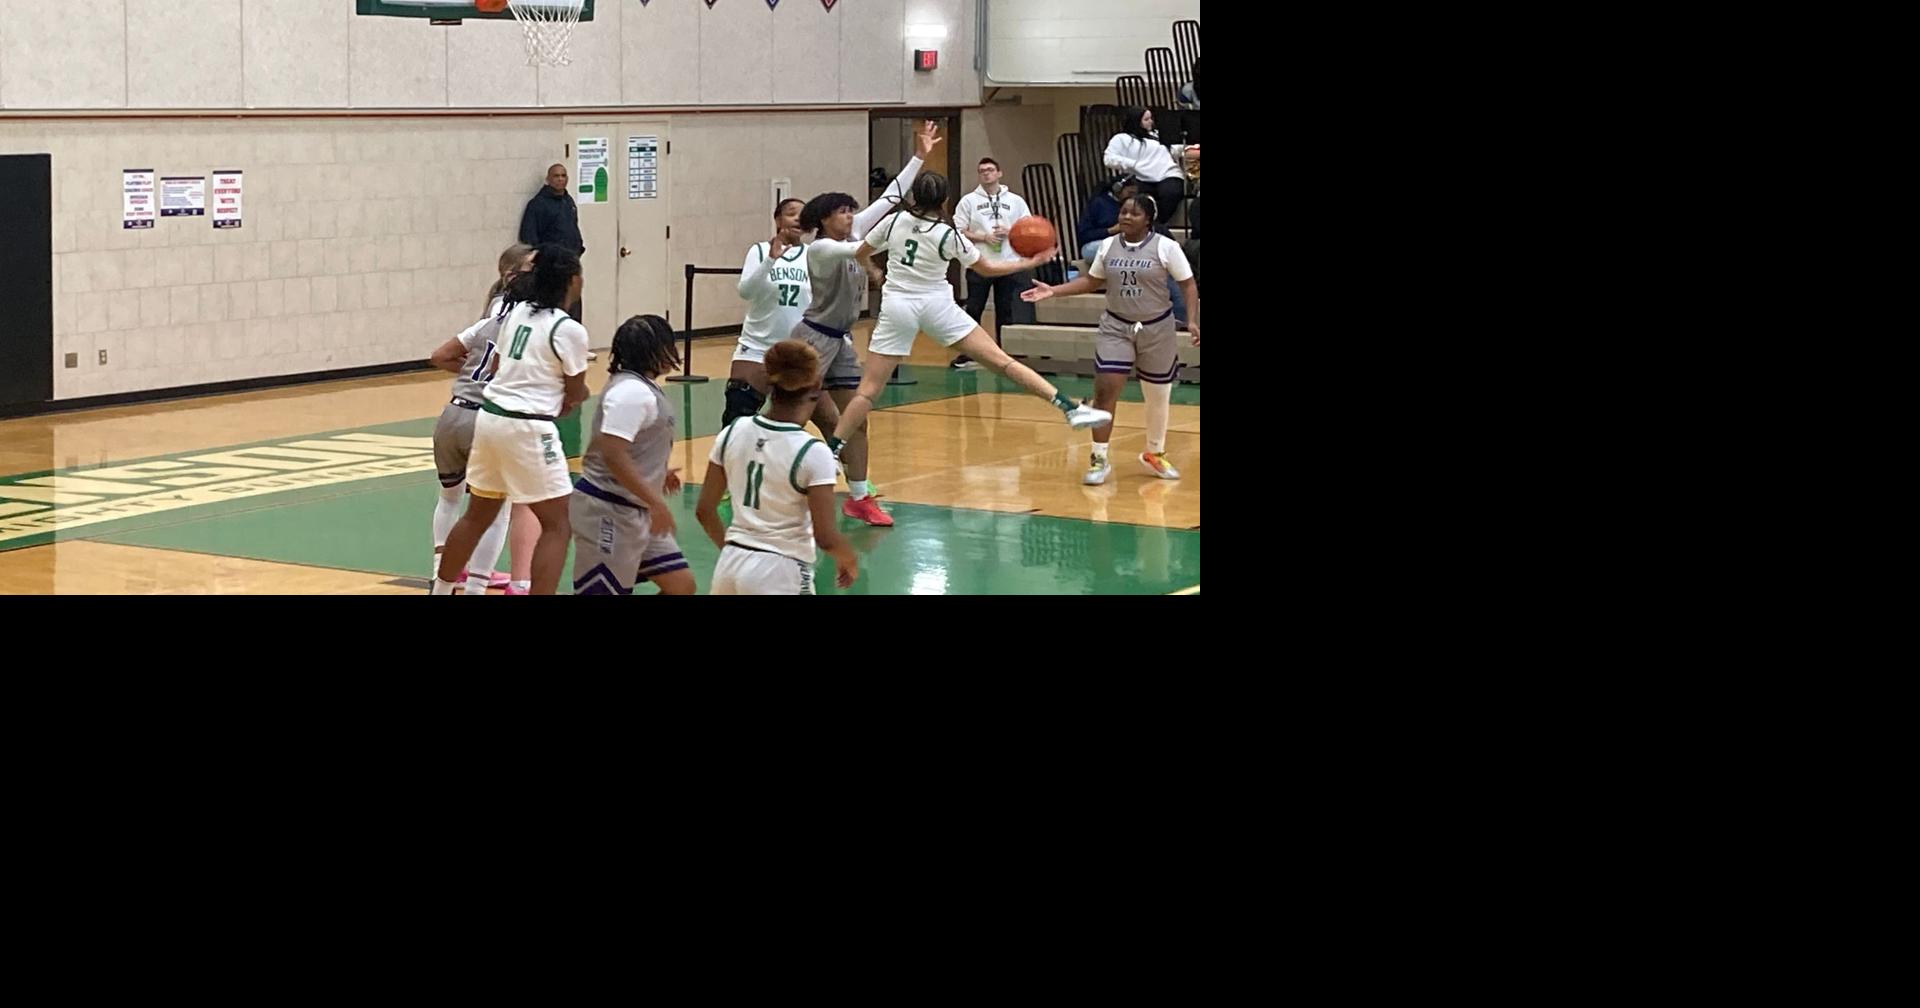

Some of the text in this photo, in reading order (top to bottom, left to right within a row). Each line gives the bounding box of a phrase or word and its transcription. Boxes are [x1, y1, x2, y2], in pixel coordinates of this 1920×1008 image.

[901, 238, 919, 267] 3
[1109, 257, 1152, 270] BELLEVUE
[770, 266, 809, 283] BENSON
[1120, 270, 1138, 286] 23
[778, 284, 800, 307] 32
[508, 324, 533, 361] 10
[0, 432, 434, 519] NSON
[744, 460, 765, 510] 11
